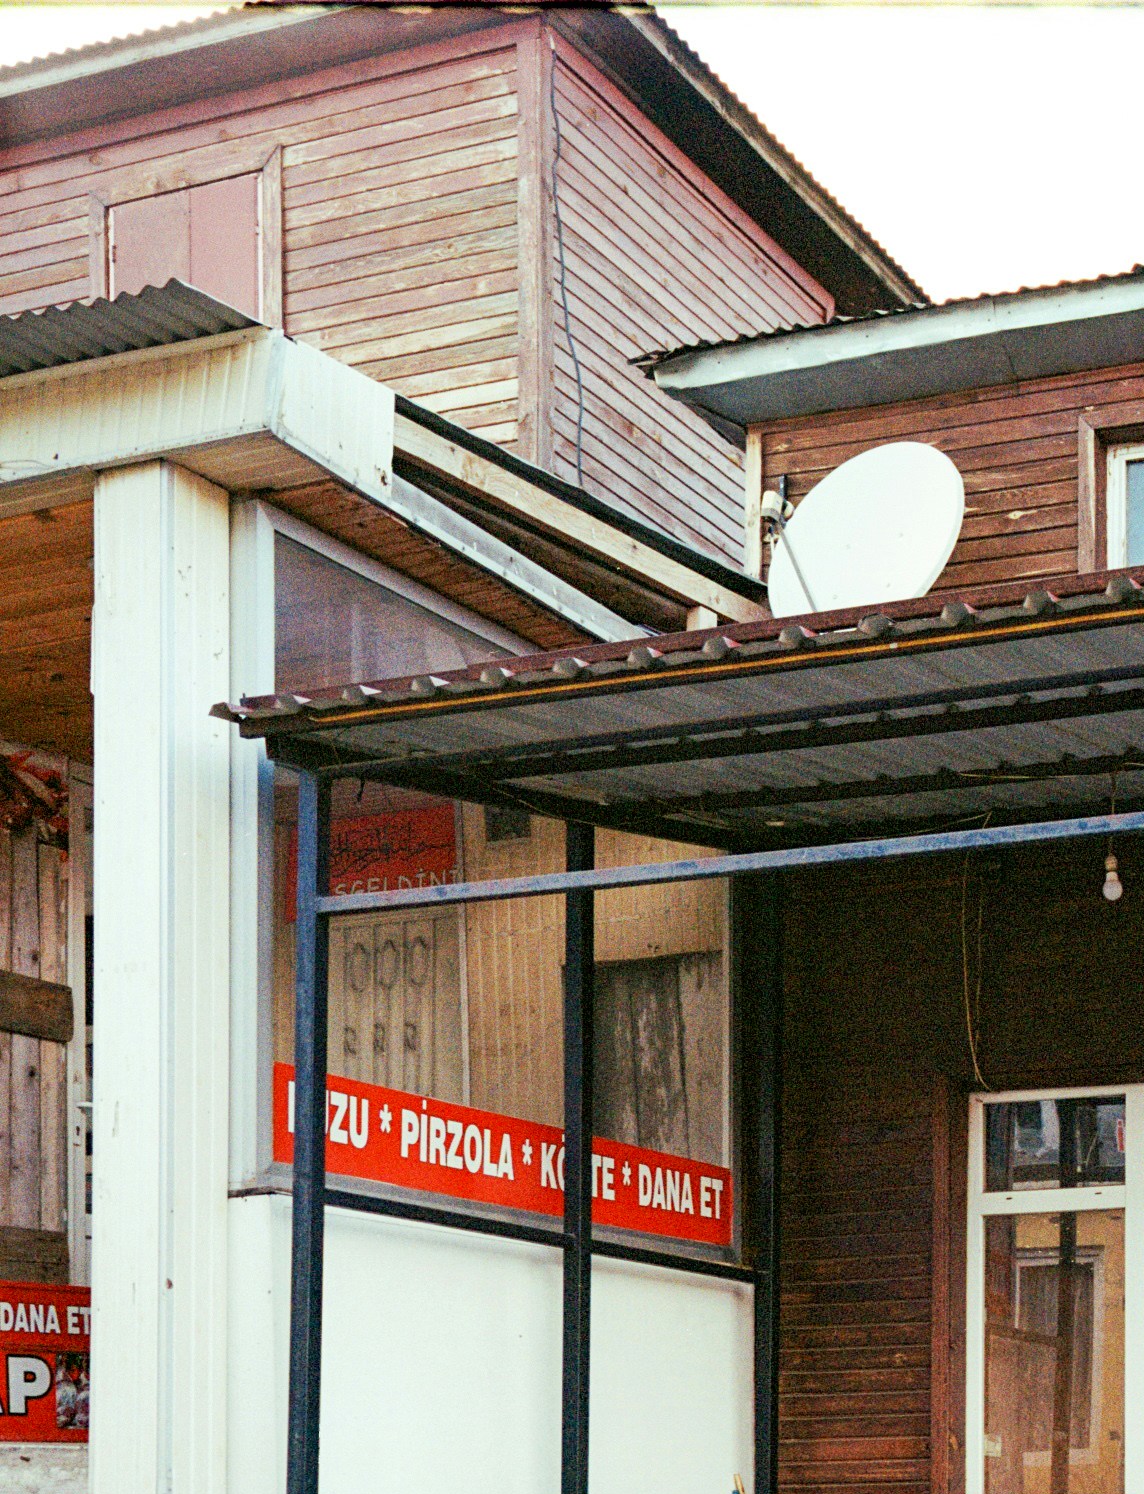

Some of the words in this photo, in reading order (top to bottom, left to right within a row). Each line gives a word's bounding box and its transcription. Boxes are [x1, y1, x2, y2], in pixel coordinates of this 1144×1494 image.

[288, 1080, 369, 1149] ZU
[400, 1099, 514, 1181] PİRZOLA
[541, 1134, 616, 1201] KTE
[638, 1163, 694, 1215] DANA
[700, 1176, 724, 1219] ET
[0, 1301, 61, 1334] DANA
[66, 1306, 91, 1335] ET
